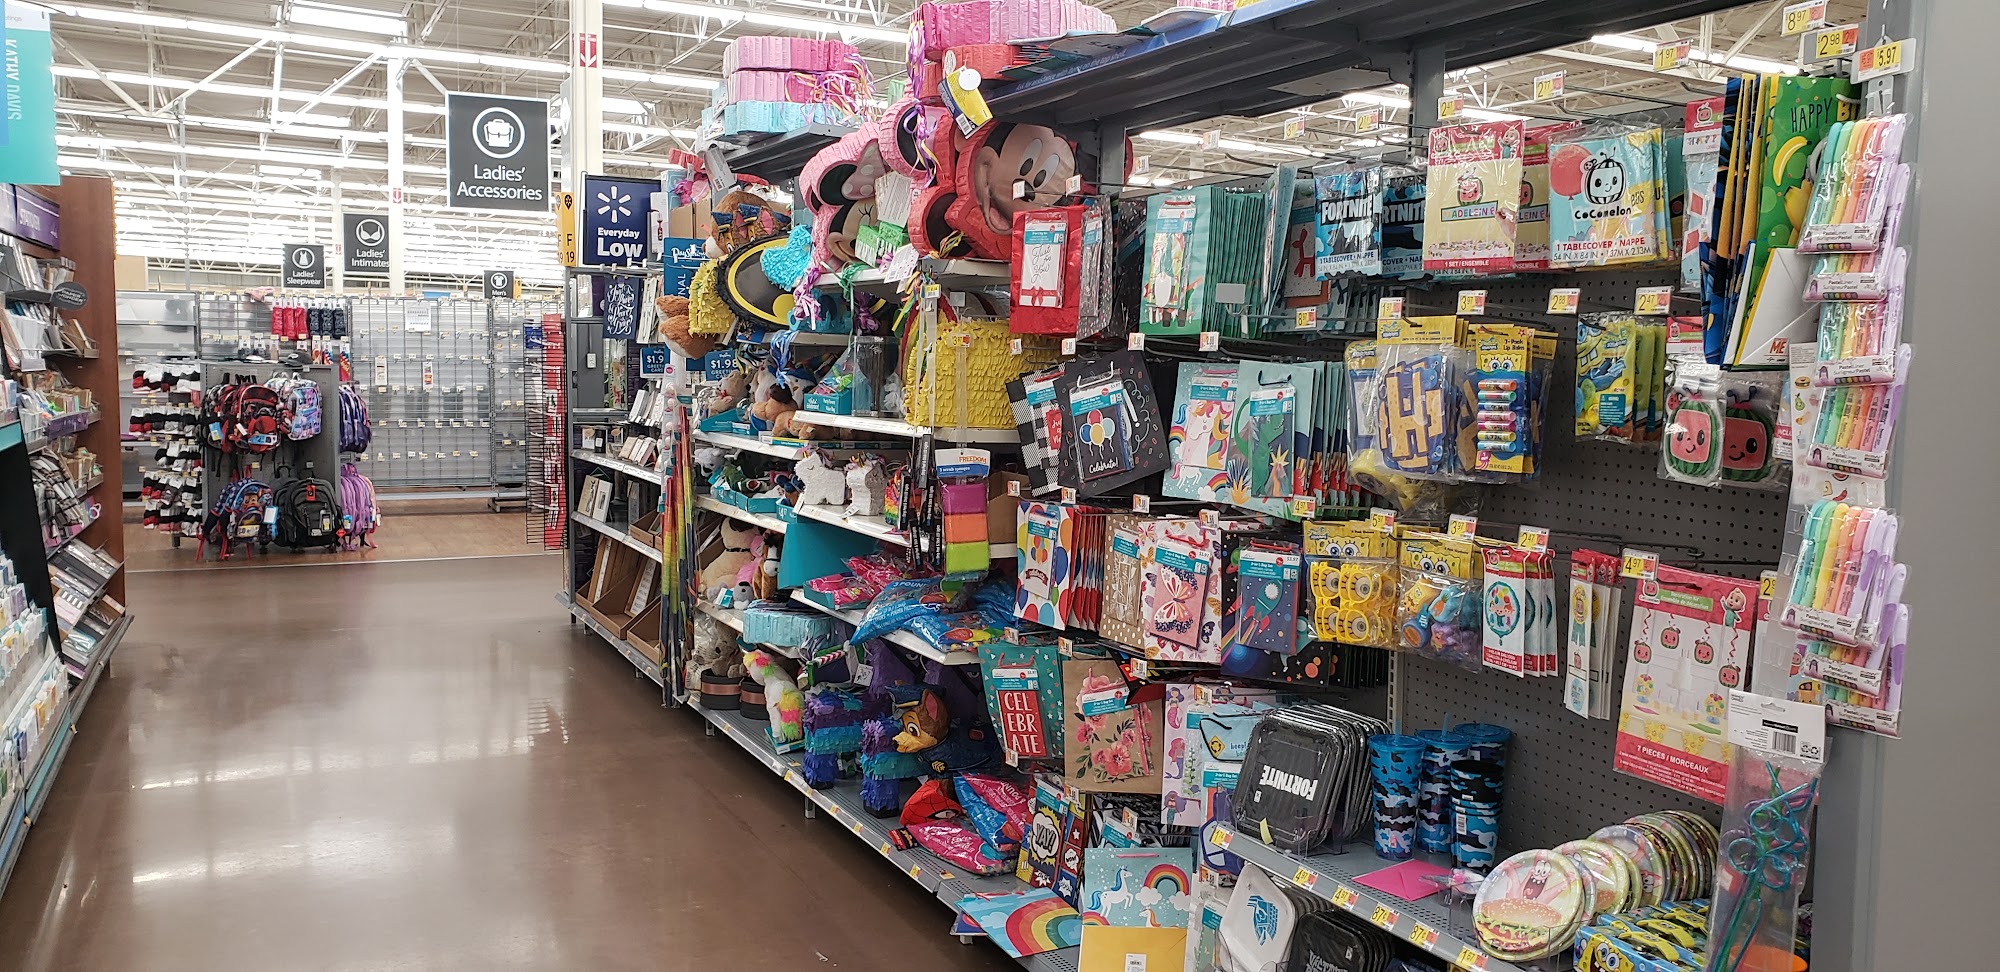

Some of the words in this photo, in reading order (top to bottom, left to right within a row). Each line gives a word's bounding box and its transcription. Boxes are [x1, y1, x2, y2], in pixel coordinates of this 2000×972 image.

[1790, 98, 1833, 133] HAPPY
[474, 164, 526, 181] Ladies'
[456, 182, 543, 201] Accessories
[1322, 196, 1373, 222] FORTNITE
[1574, 206, 1632, 220] CoComelon
[598, 228, 640, 240] Everyday
[1563, 239, 1612, 250] TABLECOVER
[1620, 237, 1645, 247] NAPPE
[356, 249, 385, 258] Ladies'
[566, 251, 574, 263] 19
[351, 258, 389, 267] Intimates
[1770, 340, 1787, 354] ME
[711, 360, 738, 368] $1.98
[1089, 456, 1119, 473] Celebrate!
[1004, 692, 1032, 711] CEL
[1007, 713, 1038, 732] EBR
[1012, 734, 1041, 754] ATE
[1642, 746, 1666, 760] PIECES
[1670, 756, 1709, 774] MORCEAUX
[1259, 765, 1318, 801] FORTNITE
[1036, 823, 1056, 854] YAY!
